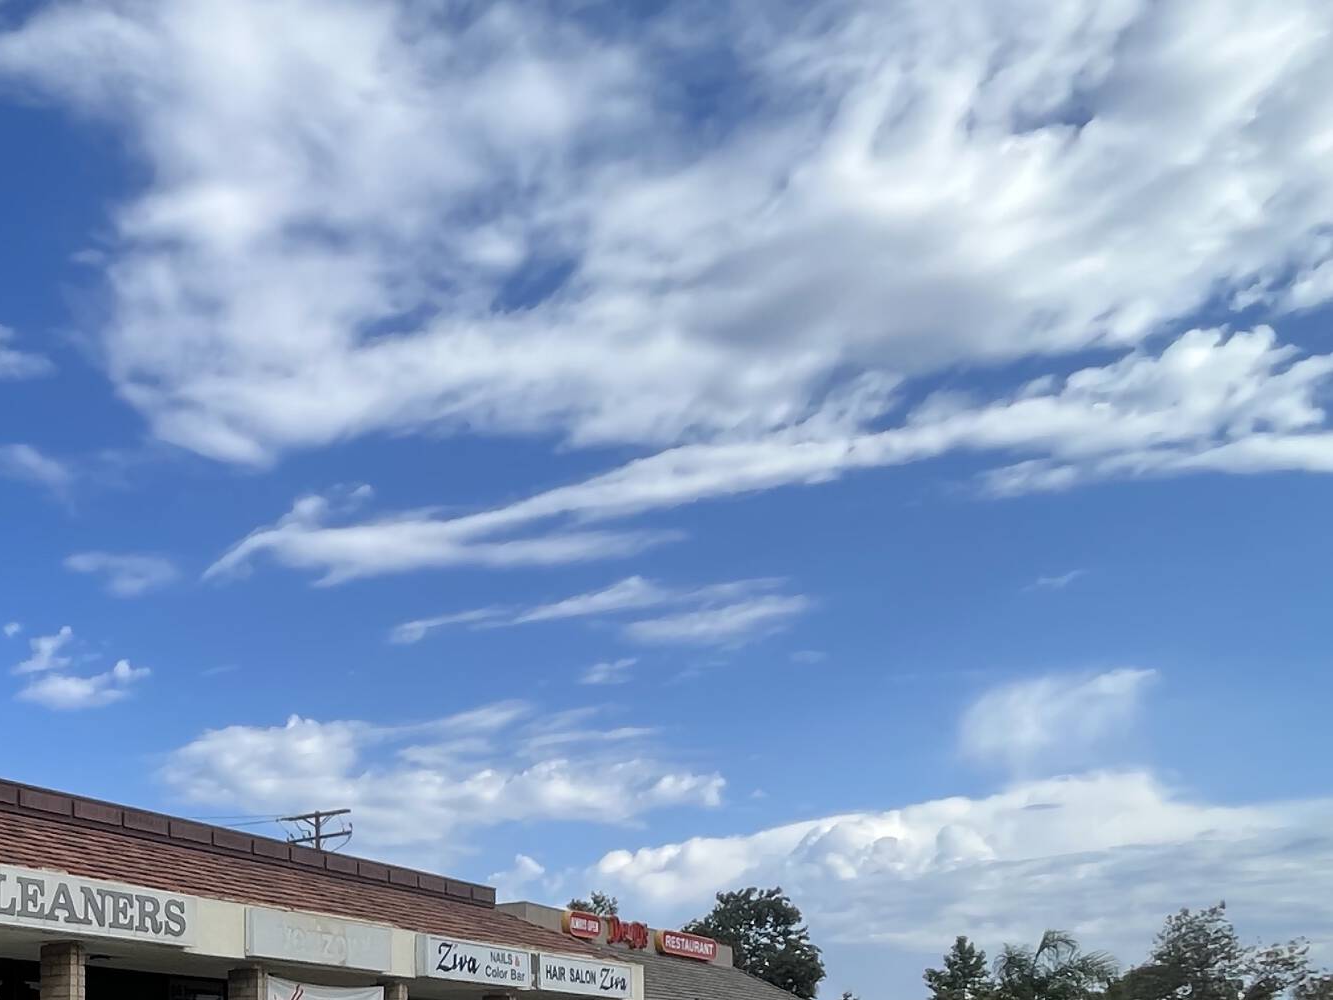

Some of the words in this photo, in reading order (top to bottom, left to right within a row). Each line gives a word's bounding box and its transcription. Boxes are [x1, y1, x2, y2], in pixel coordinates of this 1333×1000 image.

[665, 935, 714, 955] RESTAURANT
[436, 942, 481, 975] Ziva
[490, 952, 513, 966] NAILS
[485, 965, 508, 979] Color
[510, 968, 525, 981] Bar
[546, 964, 566, 982] HAIR
[569, 968, 597, 985] SALON
[599, 968, 627, 990] Ziva
